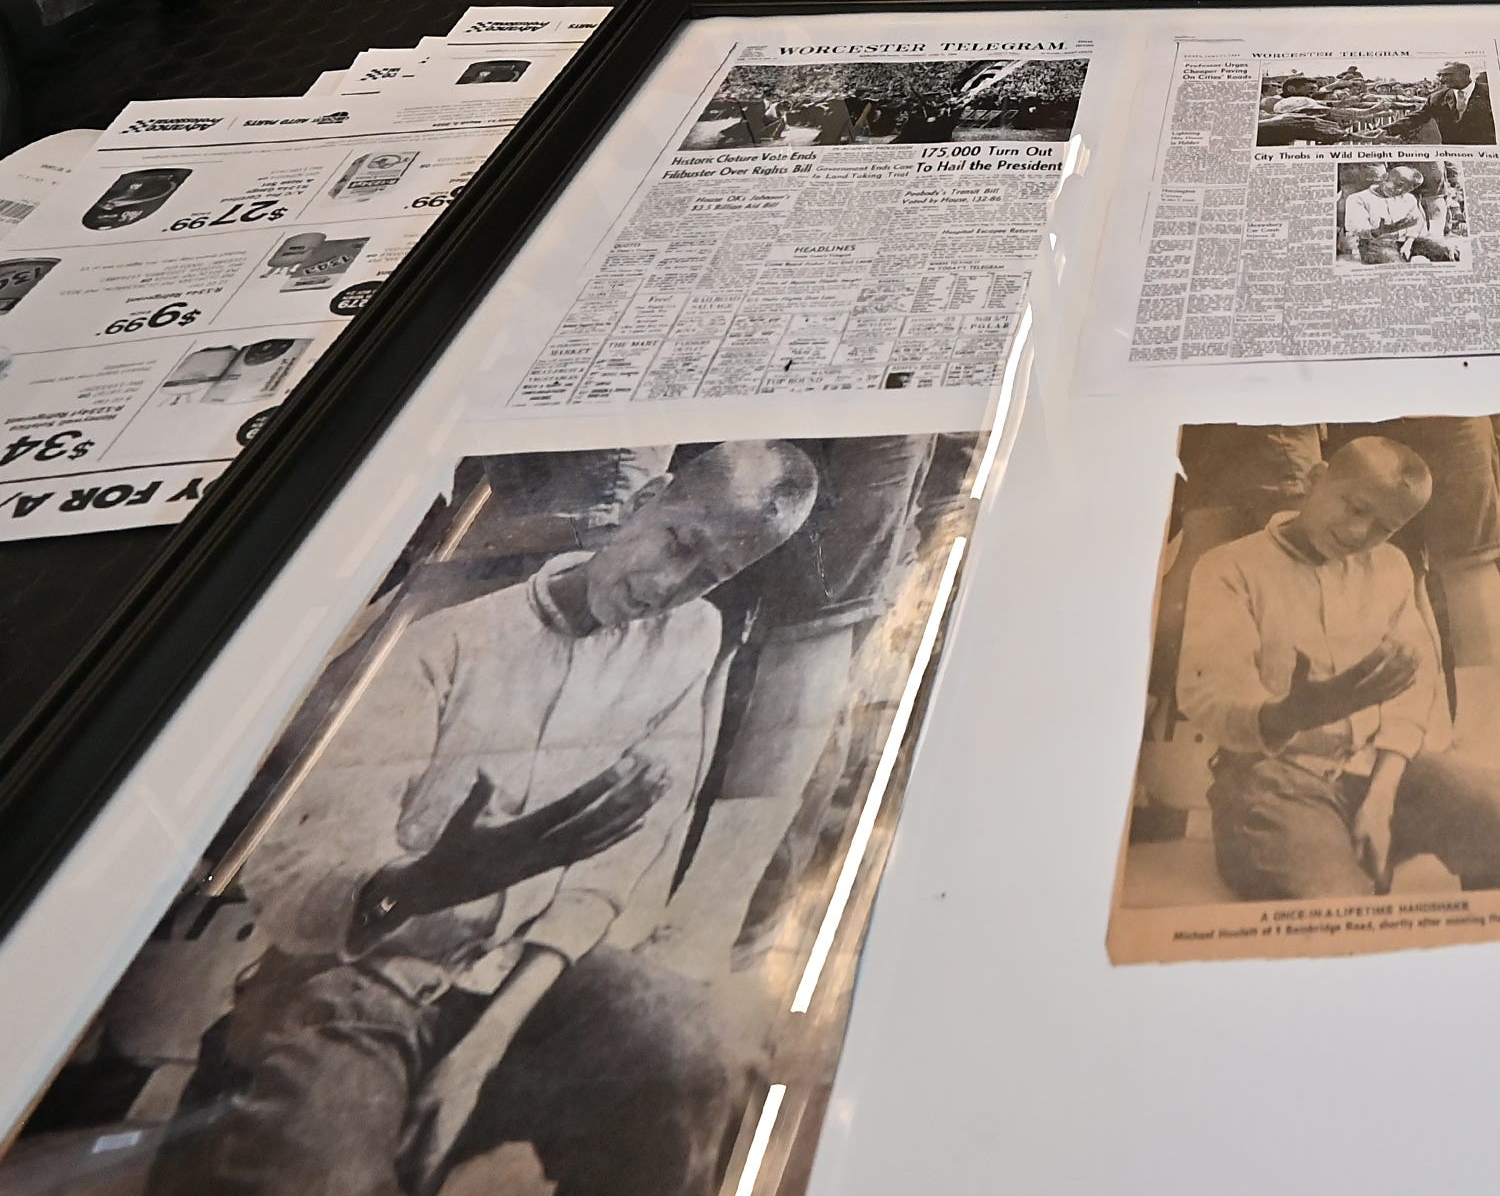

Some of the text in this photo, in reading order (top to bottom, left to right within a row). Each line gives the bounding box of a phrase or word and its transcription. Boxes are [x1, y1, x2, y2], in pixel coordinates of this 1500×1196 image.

[778, 43, 926, 56] WORCESTER
[671, 152, 817, 166] Historic Cloture Vote Ends
[920, 145, 1053, 159] 175,000 Turn Out
[1254, 152, 1274, 162] City
[1280, 152, 1311, 160] Throbs
[1330, 151, 1353, 159] Wild
[1357, 151, 1393, 160] Delight
[1397, 151, 1430, 160] During
[1435, 150, 1474, 158] Johnson
[1478, 151, 1500, 159] Visit
[661, 163, 812, 180] Filibuster Over Rights Bill
[915, 159, 1063, 174] To Hail the President
[851, 172, 882, 181] Taking
[887, 171, 910, 179] Trial
[794, 244, 856, 253] HEADLINES
[58, 479, 163, 513] FOR
